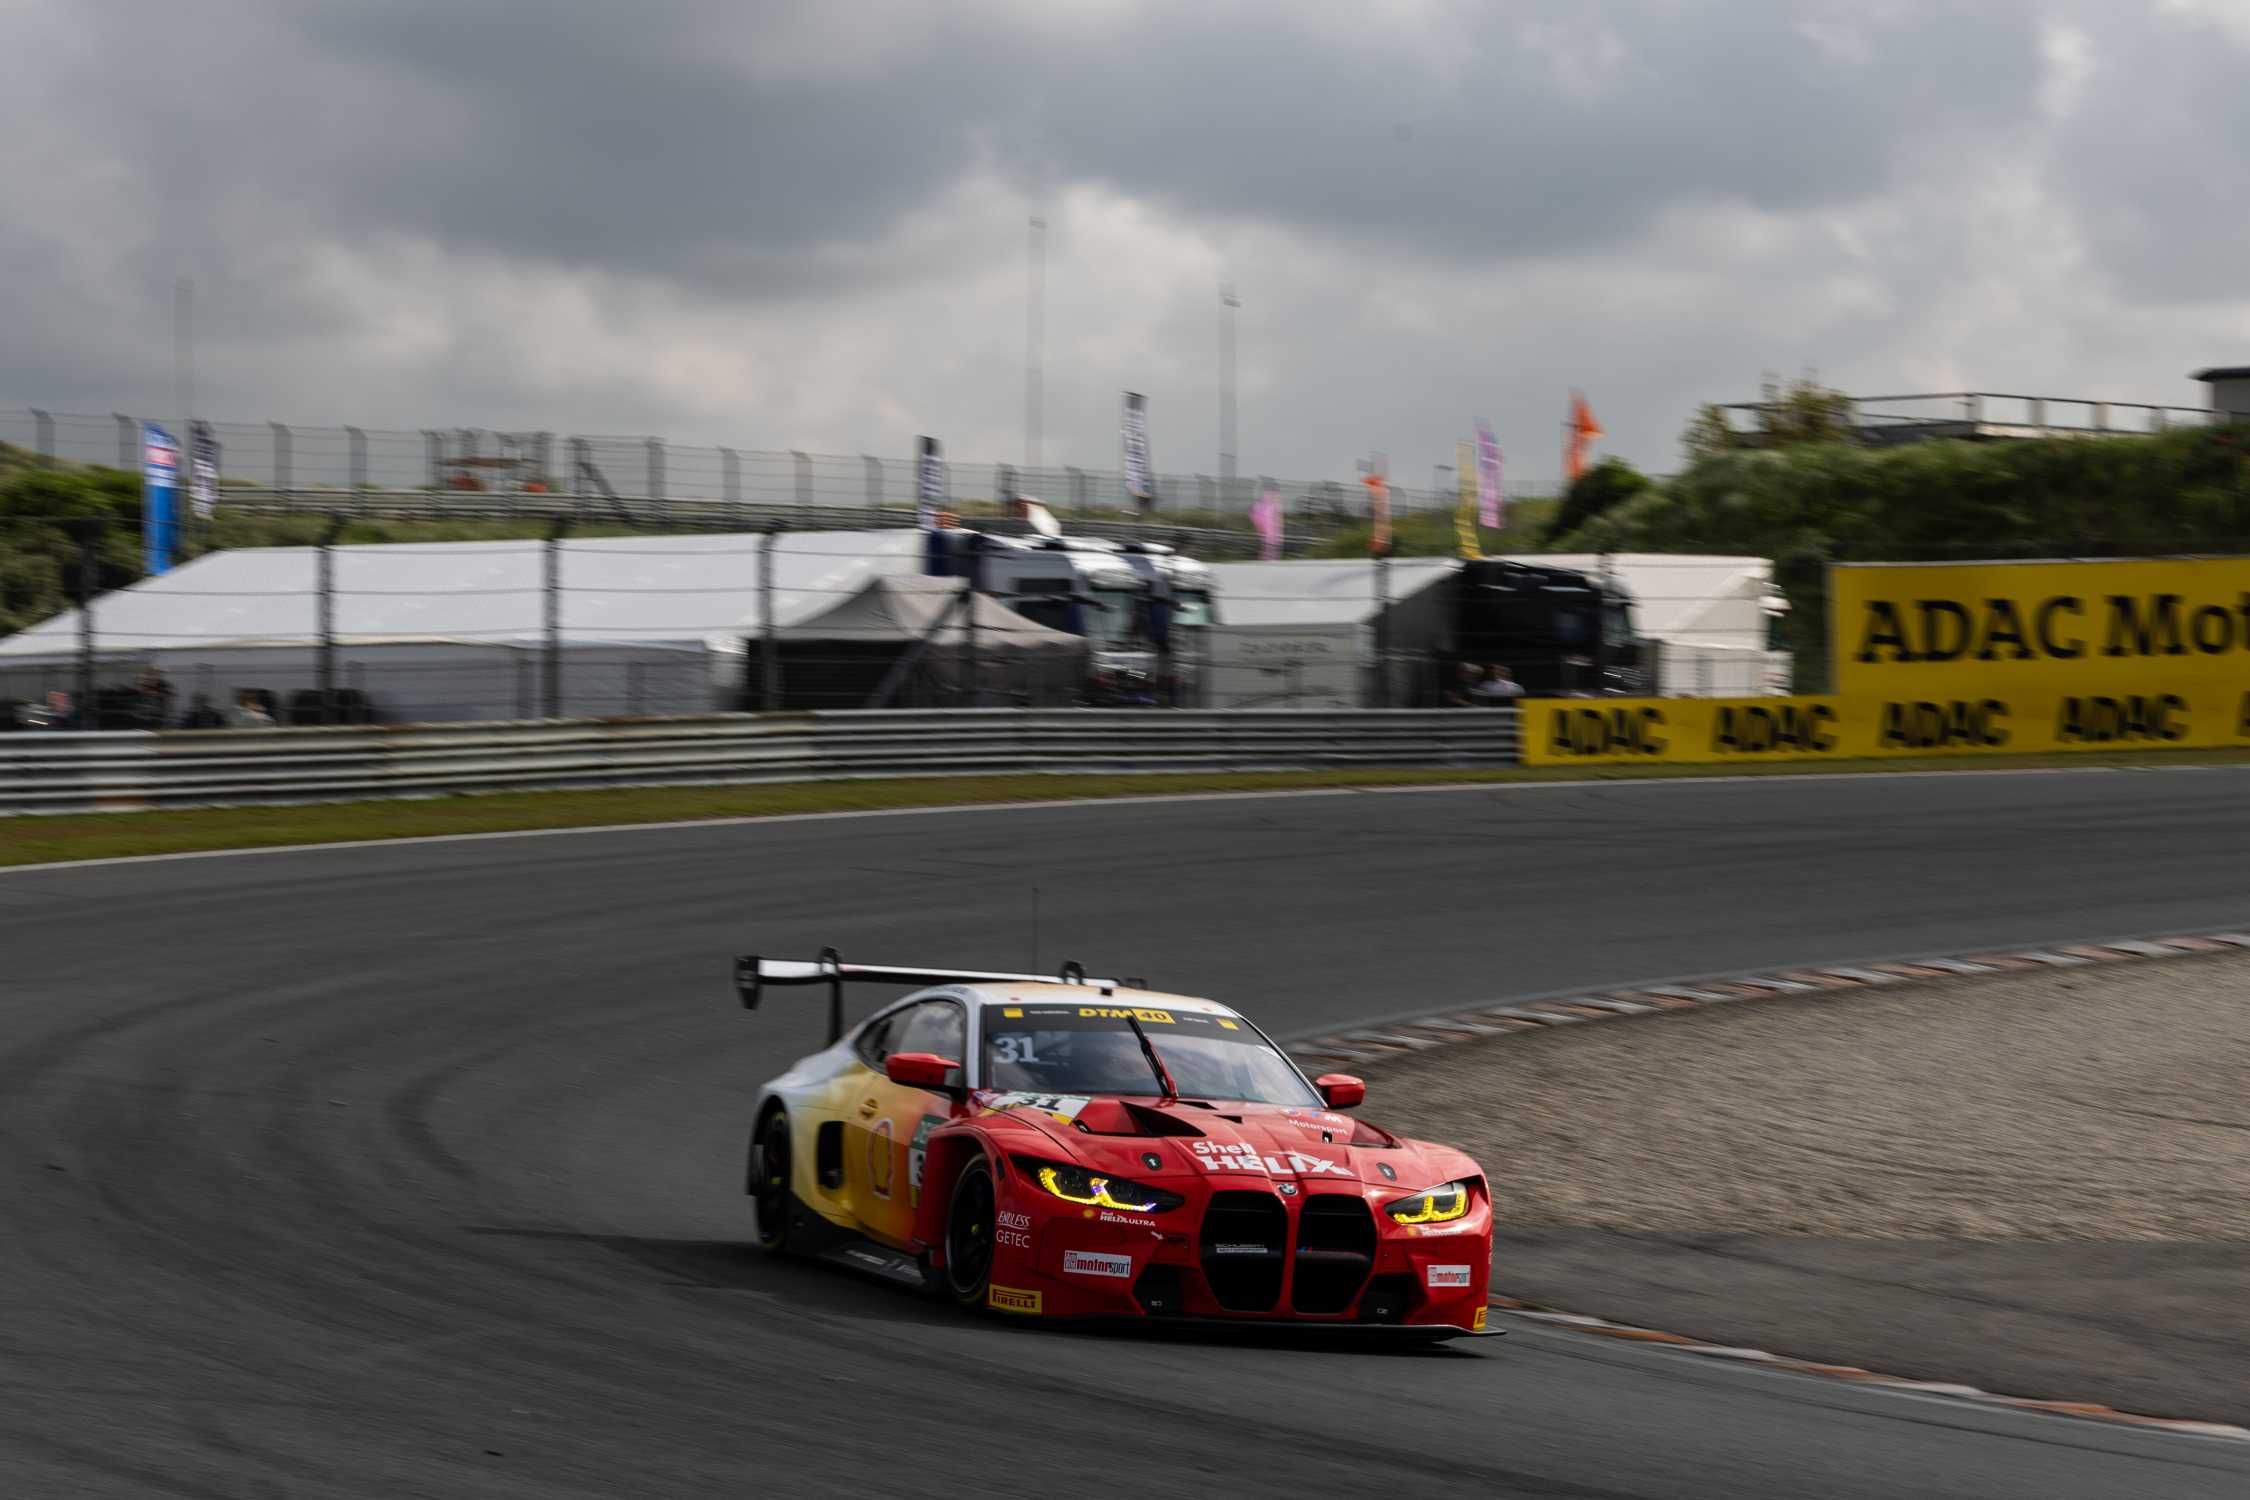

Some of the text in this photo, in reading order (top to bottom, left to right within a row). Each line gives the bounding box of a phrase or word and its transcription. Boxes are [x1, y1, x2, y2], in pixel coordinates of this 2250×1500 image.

[1856, 597, 2087, 662] ADAC
[1548, 707, 1668, 756] ADAC
[1711, 704, 1838, 754] ADAC
[1879, 700, 2013, 748] ADAC
[2056, 694, 2192, 742] ADAC
[993, 1036, 1039, 1064] 31
[1288, 1119, 1349, 1136] Motorsport
[1192, 1140, 1257, 1155] Shell
[1201, 1147, 1355, 1177] HELIX
[1129, 1218, 1156, 1227] ULTRA
[996, 1229, 1031, 1248] GETEC
[992, 1288, 1037, 1309] PIRELLI
